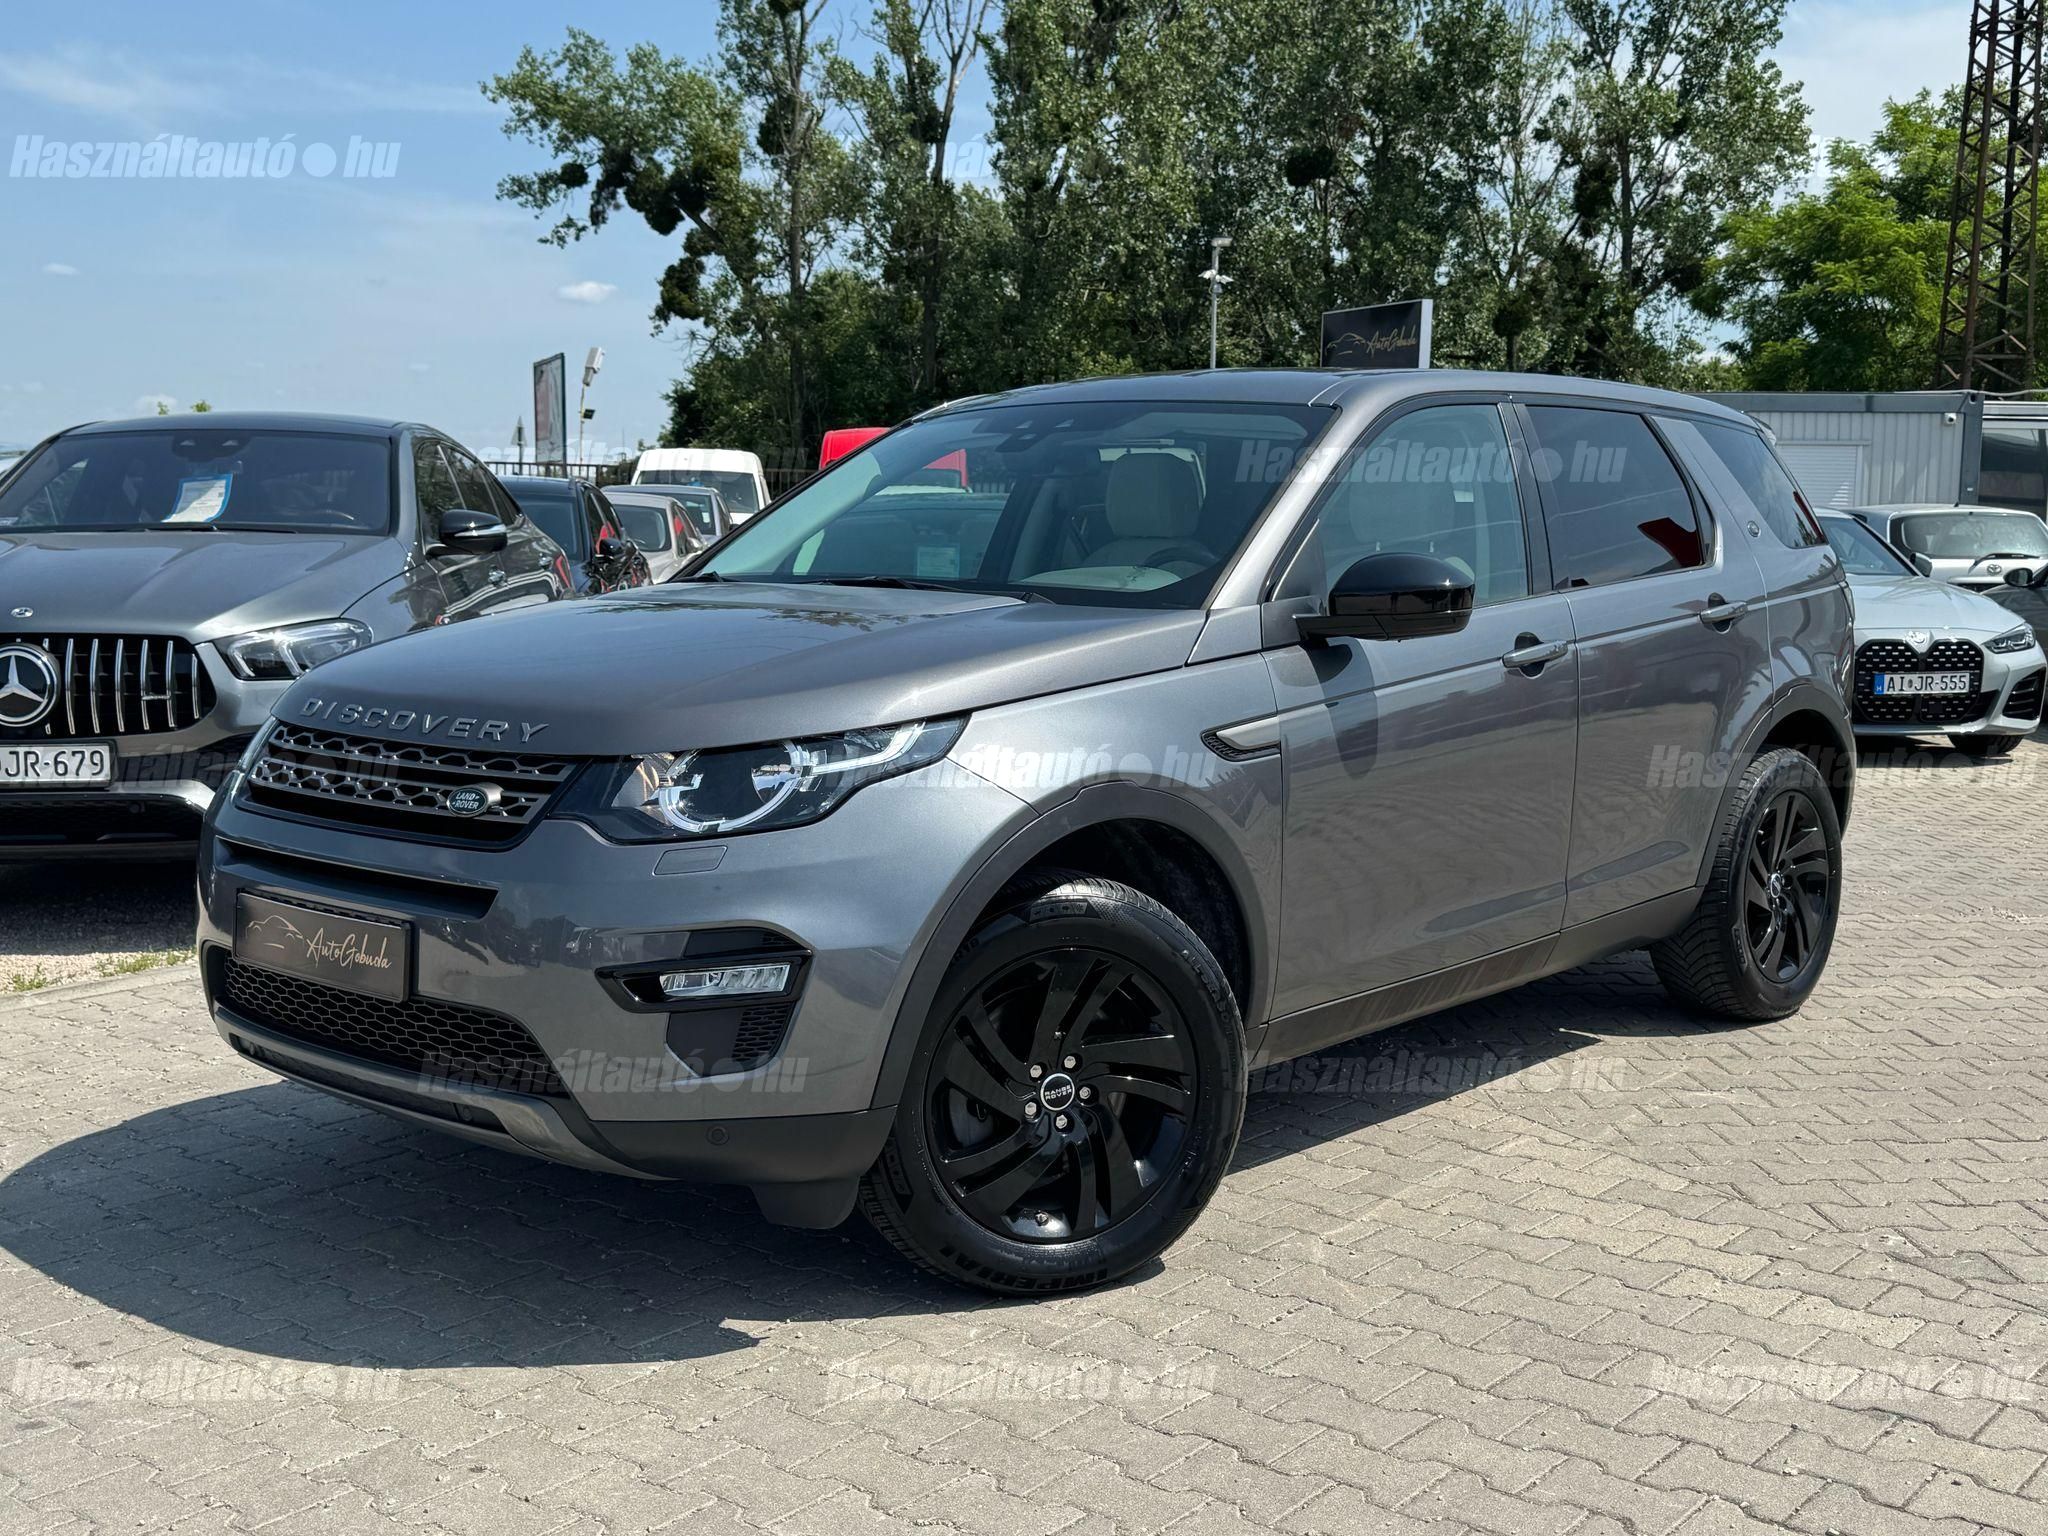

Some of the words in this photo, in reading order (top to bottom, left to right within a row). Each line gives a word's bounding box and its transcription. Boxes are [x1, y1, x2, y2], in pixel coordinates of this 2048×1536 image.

[1886, 675, 1906, 692] AI
[1914, 675, 1967, 691] JR-555
[300, 698, 549, 743] DISCOVERY
[4, 750, 105, 778] JR-679
[455, 790, 476, 800] LAND
[454, 800, 479, 809] ROVER
[306, 927, 393, 969] AutoGobuda
[1044, 1084, 1071, 1097] RANGE
[1045, 1089, 1073, 1101] ROVER
